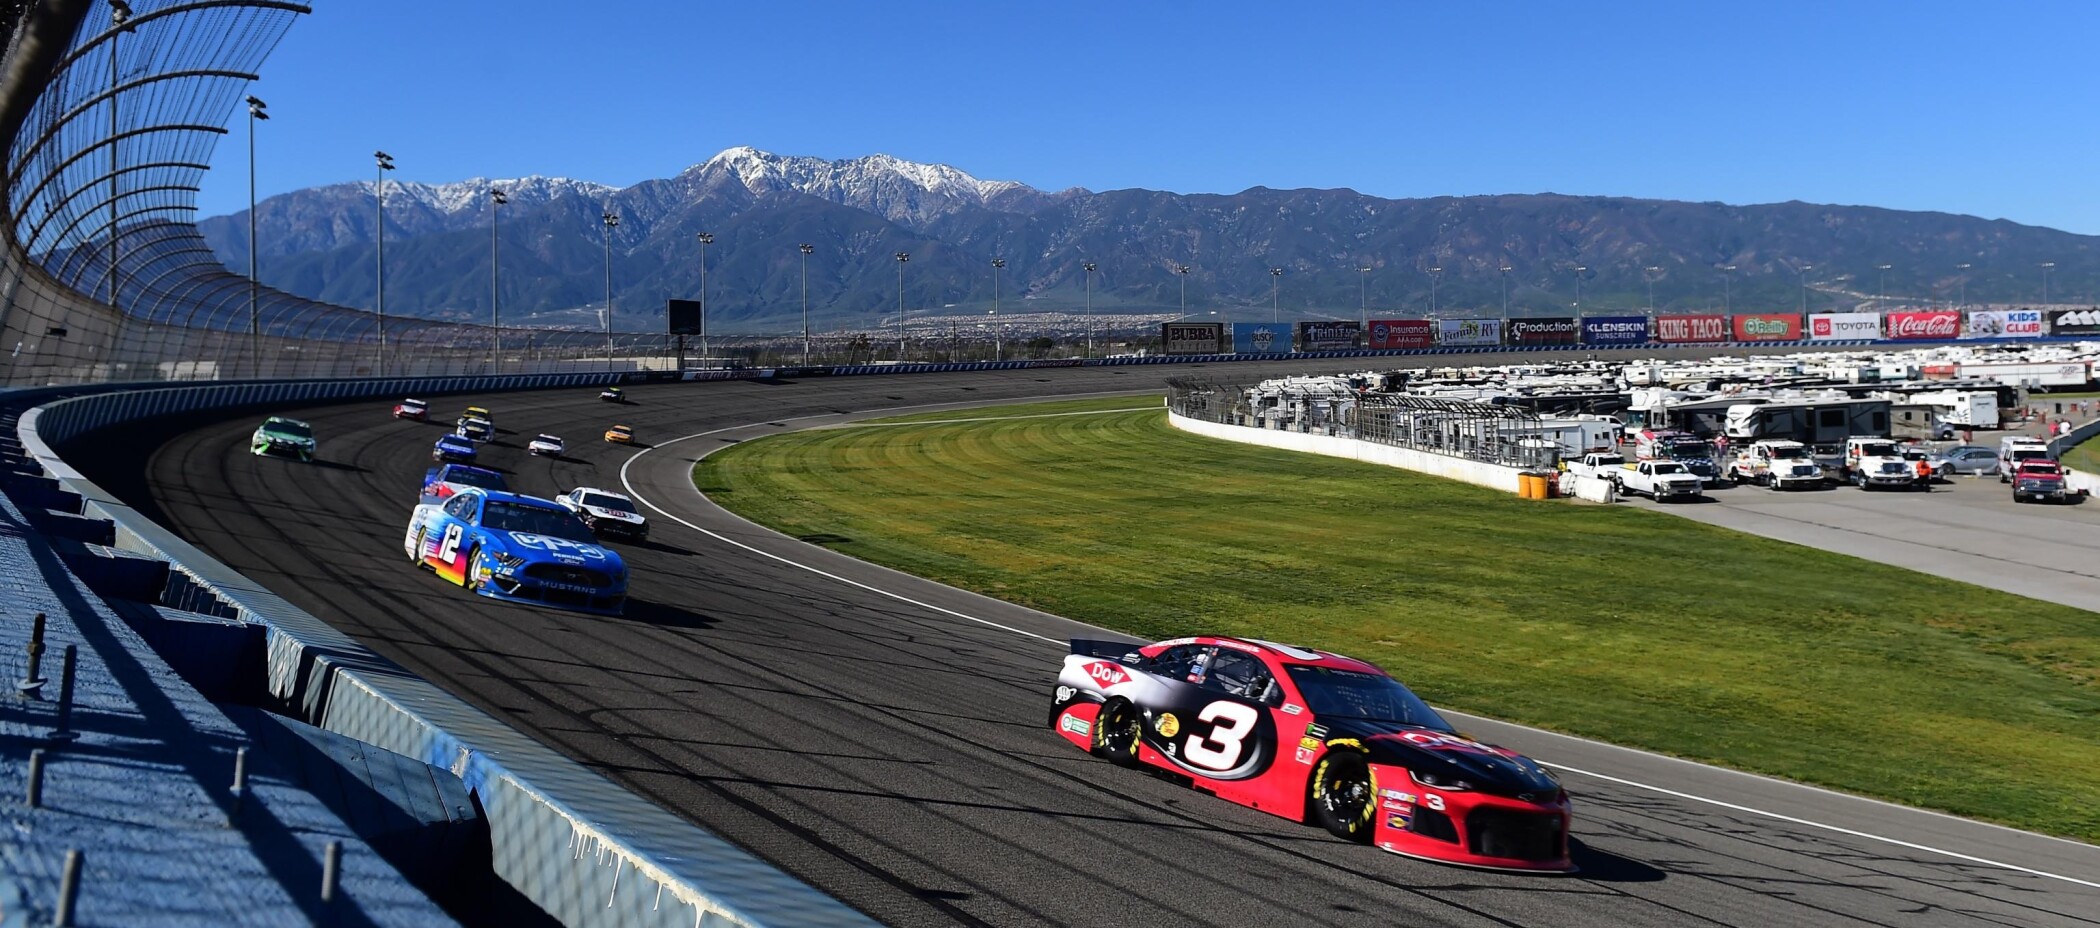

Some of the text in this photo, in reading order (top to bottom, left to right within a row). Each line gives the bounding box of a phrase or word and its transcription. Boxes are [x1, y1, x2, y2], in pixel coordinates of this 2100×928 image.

[2008, 312, 2038, 322] KIDS
[1390, 324, 1430, 334] Insurance
[1443, 323, 1498, 341] Family RV
[1519, 322, 1574, 333] Production
[1586, 322, 1645, 333] KLENSKIN
[1659, 318, 1722, 340] KING TACO
[1744, 318, 1789, 335] O'Reilly
[1835, 321, 1876, 331] TOYOTA
[1898, 314, 1958, 336] Coca-Cola
[2006, 323, 2041, 333] CLUB
[1170, 327, 1216, 341] BUBBA
[1251, 332, 1274, 342] BUSCH
[1595, 332, 1637, 340] SUNSCREEN
[438, 522, 464, 565] 12
[539, 580, 597, 595] MUSTANG
[1184, 700, 1259, 771] 3
[1424, 793, 1446, 811] 3
